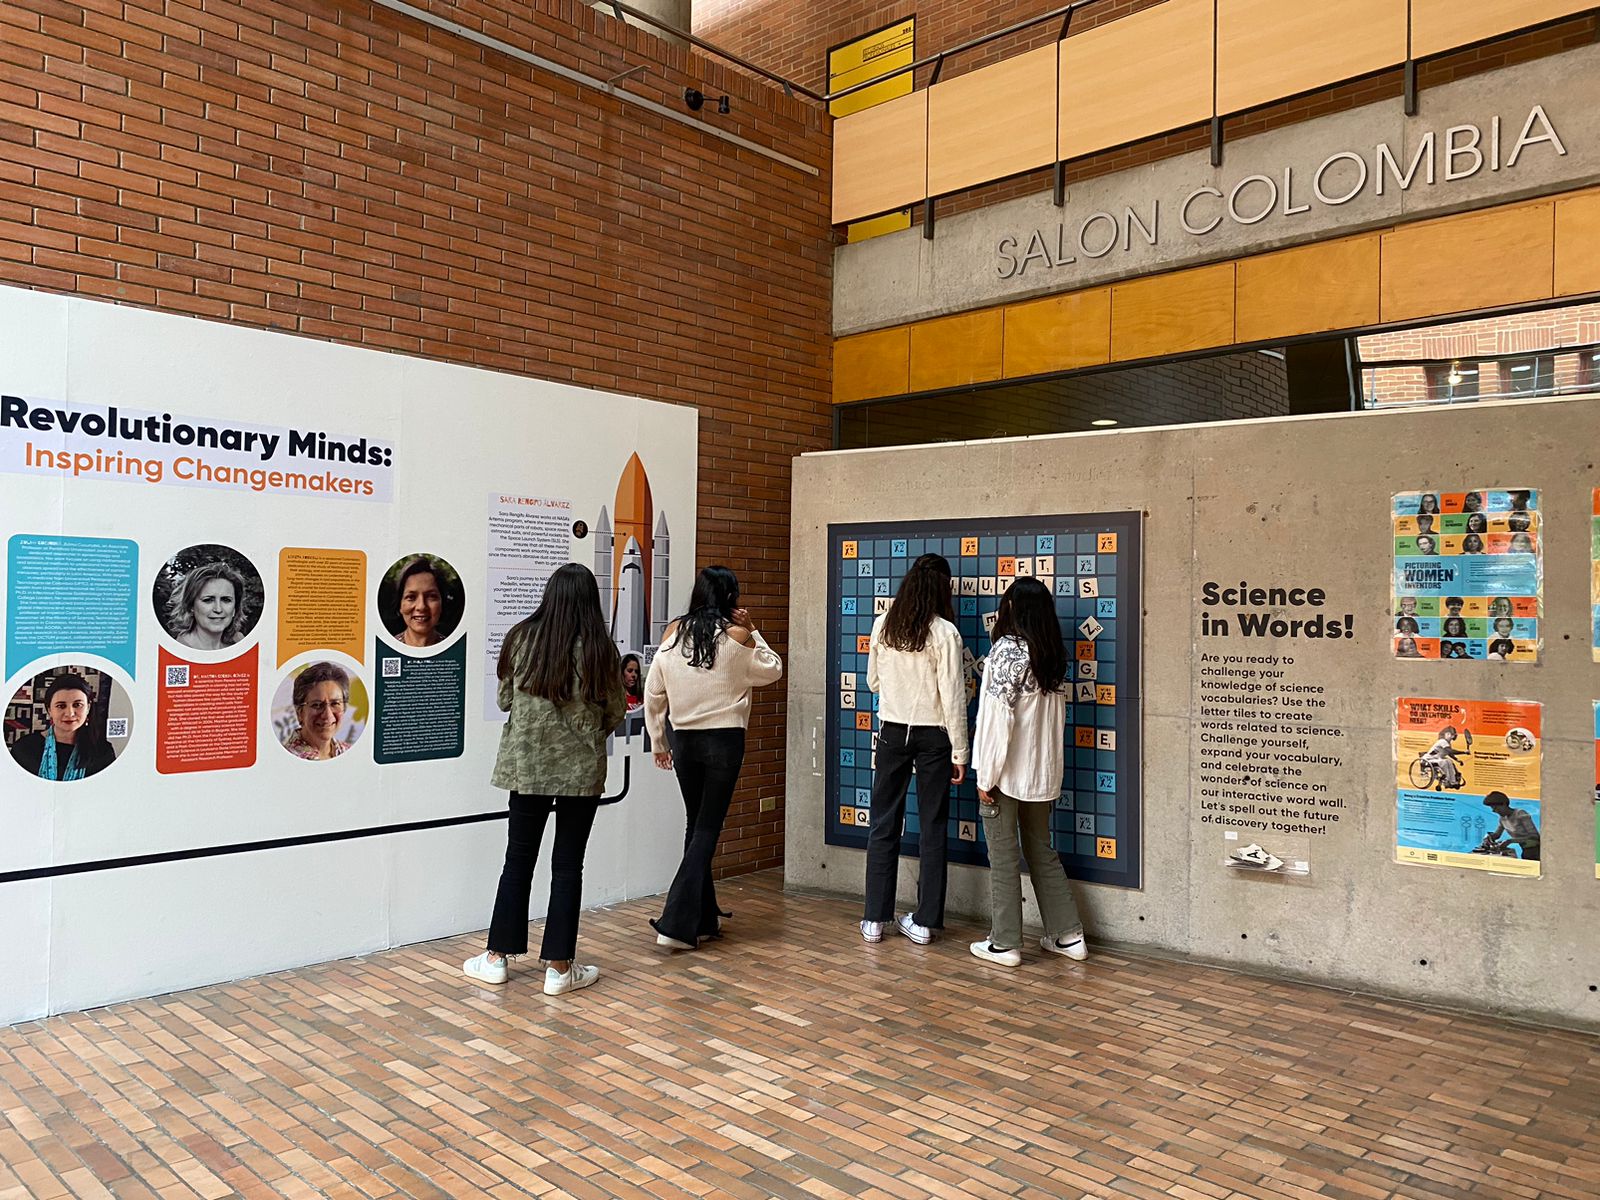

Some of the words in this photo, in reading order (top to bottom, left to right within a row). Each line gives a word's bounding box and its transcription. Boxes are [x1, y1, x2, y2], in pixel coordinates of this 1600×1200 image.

[996, 199, 1160, 280] SALON
[1179, 104, 1567, 236] COLOMBIA
[0, 395, 280, 461] Revolutionary
[288, 430, 393, 467] Minds:
[25, 442, 163, 483] Inspiring
[172, 456, 374, 496] Changemakers
[1404, 569, 1454, 582] WOMEN
[1202, 581, 1325, 606] Science
[1202, 612, 1228, 636] in
[1237, 614, 1353, 638] Words!
[1201, 653, 1219, 662] Are
[1223, 655, 1242, 664] you
[1246, 655, 1279, 666] ready
[1283, 656, 1294, 664] to
[1201, 667, 1256, 679] challenge
[1259, 670, 1284, 679] your
[1201, 680, 1261, 692] knowledge
[1265, 683, 1276, 691] of
[1280, 684, 1324, 693] science
[1201, 694, 1278, 705] vocabularies?
[1282, 697, 1302, 706] Use
[1307, 698, 1326, 707] the
[1410, 703, 1432, 711] WHAT
[1433, 704, 1460, 713] SKILLS
[1201, 706, 1230, 716] letter
[1234, 709, 1256, 718] tiles
[1260, 711, 1271, 719] to
[1275, 712, 1312, 721] create
[1201, 721, 1233, 730] words
[1237, 723, 1277, 733] related
[1281, 725, 1292, 733] to
[1296, 726, 1344, 736] science.
[1201, 733, 1258, 747] Challenge
[1261, 738, 1309, 750] yourself,
[1201, 749, 1242, 758] expand
[1246, 752, 1270, 761] your
[1274, 754, 1342, 766] vocabulary,
[1201, 761, 1221, 770] and
[1225, 763, 1279, 775] celebrate
[1283, 767, 1302, 776] the
[1201, 775, 1249, 785] wonders
[1251, 778, 1262, 786] of
[1265, 779, 1308, 790] science
[1312, 784, 1327, 792] on
[1223, 789, 1282, 802] interactive
[1287, 796, 1315, 805] word
[1319, 799, 1347, 808] wall.
[1202, 801, 1226, 811] Let's
[1229, 804, 1255, 814] spell
[1259, 807, 1277, 816] out
[1281, 808, 1300, 818] the
[1304, 810, 1339, 821] future
[1202, 815, 1212, 823] of
[1215, 816, 1268, 830] discovery
[1272, 821, 1326, 834] together!
